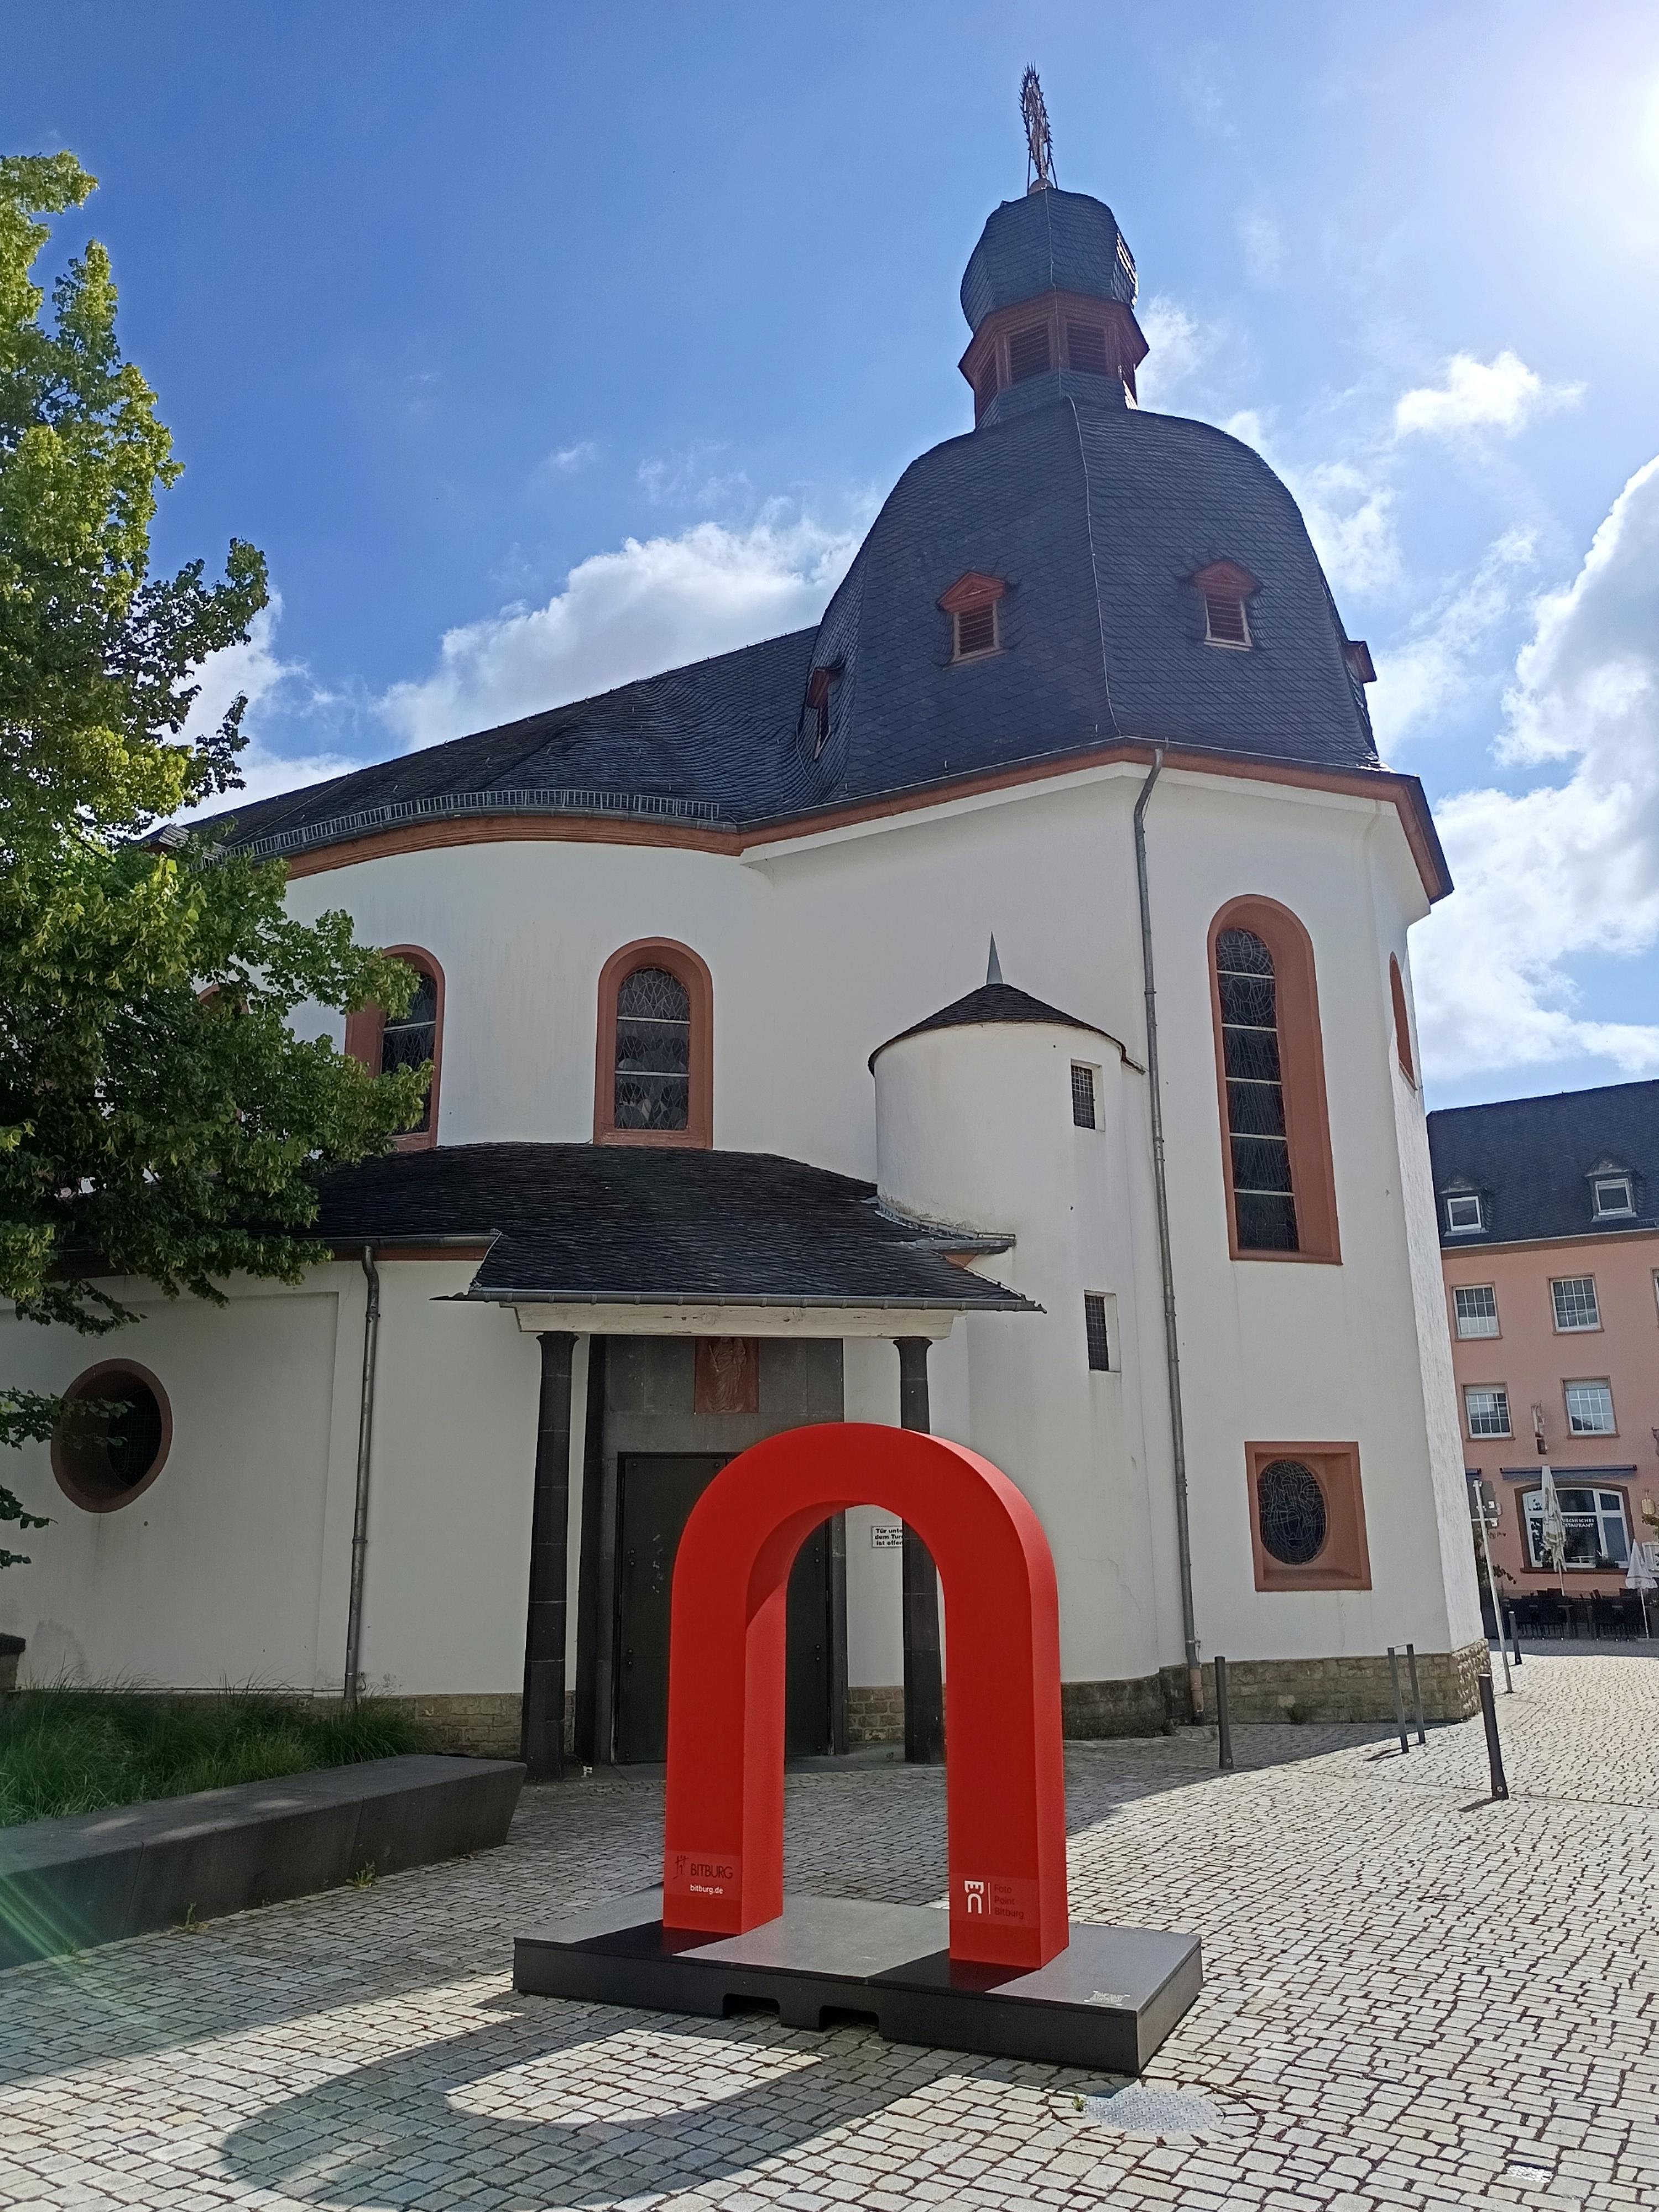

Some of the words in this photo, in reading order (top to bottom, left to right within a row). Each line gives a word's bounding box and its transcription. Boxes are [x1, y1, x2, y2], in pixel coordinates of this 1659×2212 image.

[690, 1863, 733, 1879] BITBURG
[690, 1884, 724, 1895] bitburg.de
[994, 1885, 1013, 1893] Foto
[994, 1896, 1015, 1905] Point
[994, 1907, 1024, 1919] Bitburg
